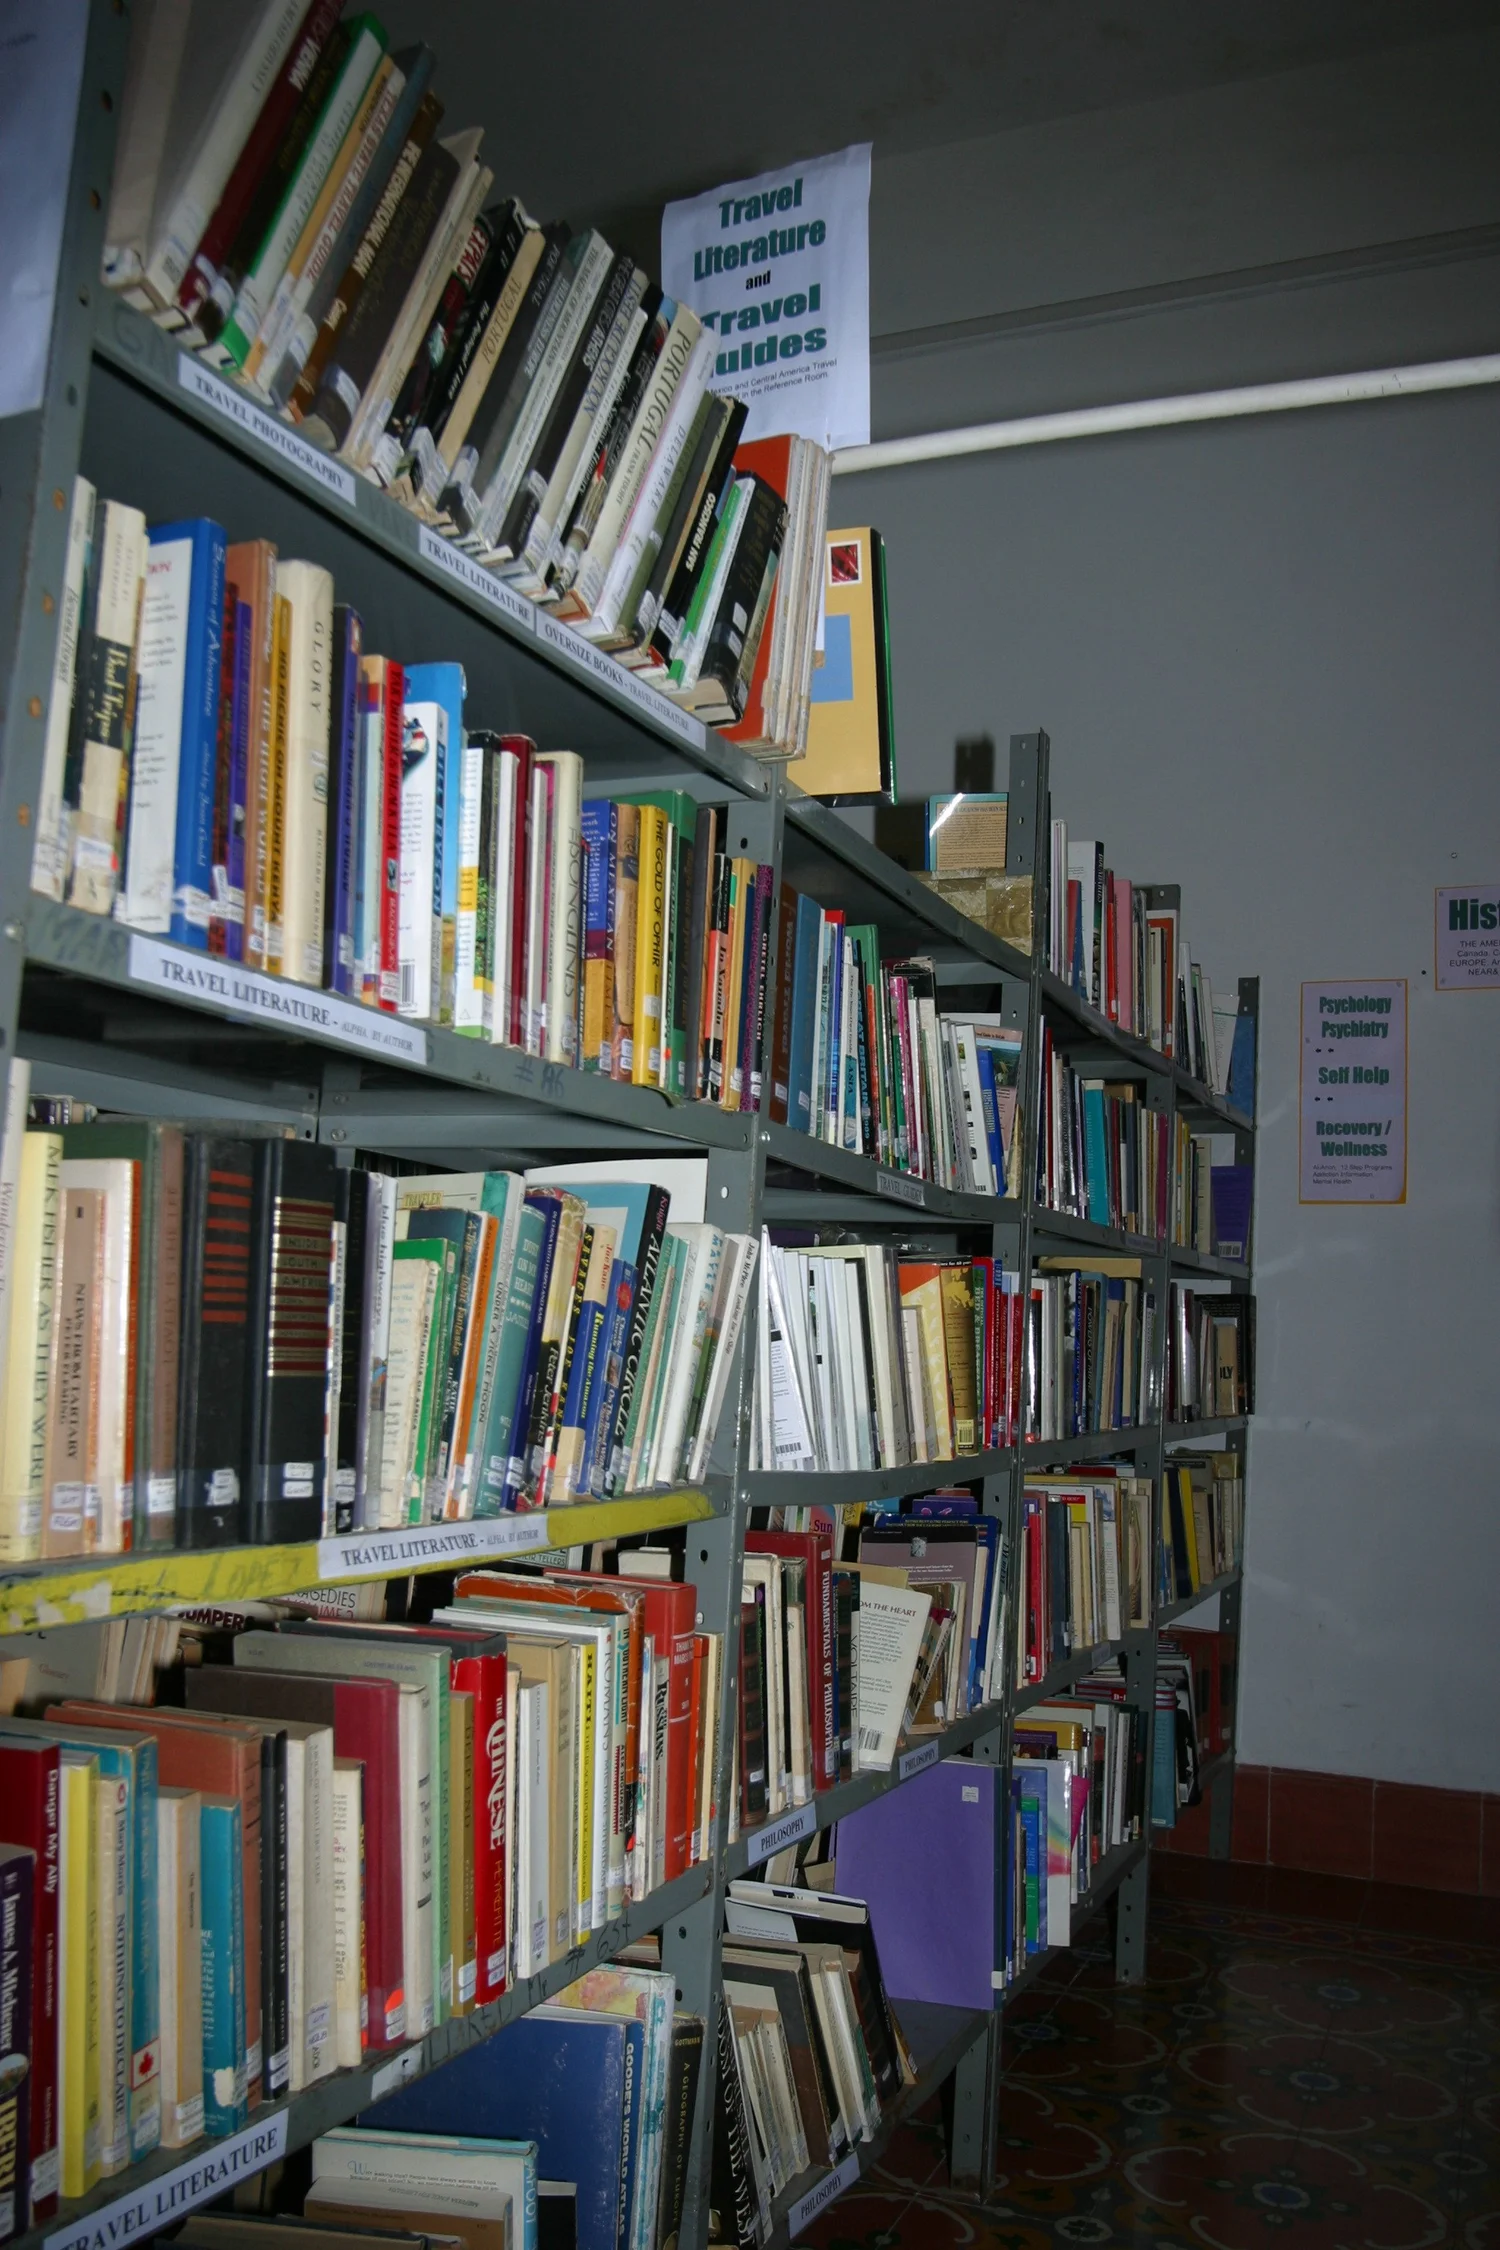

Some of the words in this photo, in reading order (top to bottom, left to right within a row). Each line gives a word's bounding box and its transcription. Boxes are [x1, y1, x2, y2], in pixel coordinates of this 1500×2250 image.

[718, 178, 804, 229] Travel
[456, 224, 488, 290] EXPATS
[693, 219, 826, 282] Literature
[745, 270, 771, 290] and
[482, 278, 522, 364] PORTUGAL
[710, 327, 827, 378] uides
[734, 381, 749, 391] and
[750, 374, 778, 386] Central
[779, 366, 810, 378] America
[813, 358, 838, 370] Travel
[637, 328, 691, 453] PORTUGAL
[751, 388, 762, 397] the
[764, 378, 802, 393] Reference
[804, 371, 829, 382] Room
[195, 375, 250, 425] TRAVEL
[252, 416, 346, 490] PHOTOGRAPHY
[650, 425, 687, 513] DELAWARE
[685, 550, 699, 573] SAN
[692, 492, 717, 552] FRANCISCO
[426, 539, 469, 579] TRAVEL
[470, 569, 531, 621] LITERATURE
[104, 645, 127, 688] Bad
[202, 627, 219, 717] Adventure
[310, 620, 325, 713] GLORY
[544, 623, 592, 667] OVERSIZE
[592, 658, 624, 686] BOOKS
[629, 682, 653, 703] TRAVEL
[653, 699, 690, 732] LITERATURE
[97, 689, 121, 742] Trips
[260, 684, 272, 732] THE
[274, 683, 286, 745] PICNIC
[257, 740, 270, 799] HIGH
[273, 748, 284, 779] ON
[435, 746, 445, 794] BILL
[271, 781, 283, 855] MOUNT
[607, 810, 617, 842] ON
[655, 818, 664, 842] THE
[255, 808, 268, 896] WORLD
[433, 804, 444, 911] BRYSON
[654, 847, 663, 890] GOLD
[269, 859, 281, 924] KENYA
[605, 852, 615, 951] MEXICAN
[653, 895, 662, 916] OF
[651, 921, 661, 968] OPHIR
[718, 945, 727, 963] In
[759, 931, 768, 979] GRETEL
[1460, 940, 1477, 948] THE
[160, 958, 229, 996] TRAVEL
[233, 980, 331, 1026] LITERATURE
[371, 1030, 382, 1041] BY
[383, 1034, 413, 1052] AUTHOR
[715, 967, 724, 1026] Xanadu
[756, 984, 765, 1041] EHRLICH
[1319, 995, 1392, 1015] Psychology
[1321, 1020, 1389, 1040] Psychiatry
[1318, 1066, 1348, 1085] Self
[1352, 1066, 1390, 1086] Help
[1316, 1120, 1381, 1137] Recovery
[1320, 1142, 1388, 1157] Wellness
[378, 1205, 390, 1240] blue
[403, 1192, 442, 1208] TRAVELER
[655, 1195, 669, 1232] Knight
[572, 1232, 593, 1315] SAVAGES
[602, 1243, 613, 1262] Joe
[374, 1244, 388, 1326] highways
[600, 1262, 612, 1291] Kane
[629, 1233, 661, 1353] ATLANTIC
[73, 1283, 85, 1331] NEWS
[493, 1281, 504, 1321] UNDER
[63, 1317, 72, 1360] PETER
[489, 1325, 499, 1335] A
[566, 1335, 576, 1368] JOE
[590, 1310, 604, 1360] Running
[617, 1315, 626, 1352] Charles
[71, 1333, 83, 1380] FROM
[546, 1347, 560, 1384] Peter
[586, 1361, 595, 1377] the
[59, 1363, 69, 1424] FLEMING
[479, 1381, 489, 1424] MOON
[537, 1384, 553, 1445] Jenkins
[581, 1377, 592, 1419] Amazon
[614, 1353, 640, 1439] CIRCLE
[68, 1385, 81, 1461] TARTARY
[341, 1542, 398, 1567] TRAVEL
[400, 1533, 478, 1559] LITERATURE
[516, 1529, 539, 1542] AUTHOR
[813, 1518, 833, 1534] Sun
[538, 1554, 566, 1568] TELLERS
[622, 1627, 630, 1639] IN
[822, 1570, 833, 1661] FUNDAMENTALS
[873, 1602, 889, 1612] THE
[890, 1605, 917, 1617] HEART
[823, 1662, 832, 1676] OF
[850, 1634, 859, 1719] VOLTAIRE
[496, 1697, 505, 1720] THE
[655, 1681, 669, 1761] RUSSIANS
[823, 1681, 833, 1754] PHILOSOPH
[905, 1746, 935, 1773] PHILOSOPHY
[46, 1768, 59, 1828] Danger
[486, 1718, 506, 1850] CHINESE
[278, 1802, 286, 1846] TURN
[462, 1786, 473, 1830] END
[45, 1831, 58, 1858] My
[116, 1819, 126, 1851] Mary
[760, 1816, 805, 1852] PHILOSOPHY
[44, 1863, 57, 1894] Ally
[114, 1854, 125, 1897] Morris
[277, 1853, 285, 1871] IN
[277, 1880, 285, 1913] THE
[2, 1893, 20, 1949] James
[2, 1948, 17, 1967] A.
[115, 1913, 128, 2003] NOTHING
[276, 1919, 285, 1974] SOUTH
[0, 1966, 18, 2050] Michener
[113, 2005, 126, 2030] TO
[112, 2032, 125, 2117] DECLARE
[624, 2042, 635, 2119] GOODE'S
[682, 2062, 690, 2071] A
[678, 2076, 689, 2152] GEOGRAPHY
[156, 2127, 277, 2215] LITERATURE
[622, 2121, 632, 2183] WORLD
[676, 2155, 683, 2170] OF
[618, 2184, 628, 2236] ATLAS
[800, 2174, 842, 2220] PHILOSOPHY
